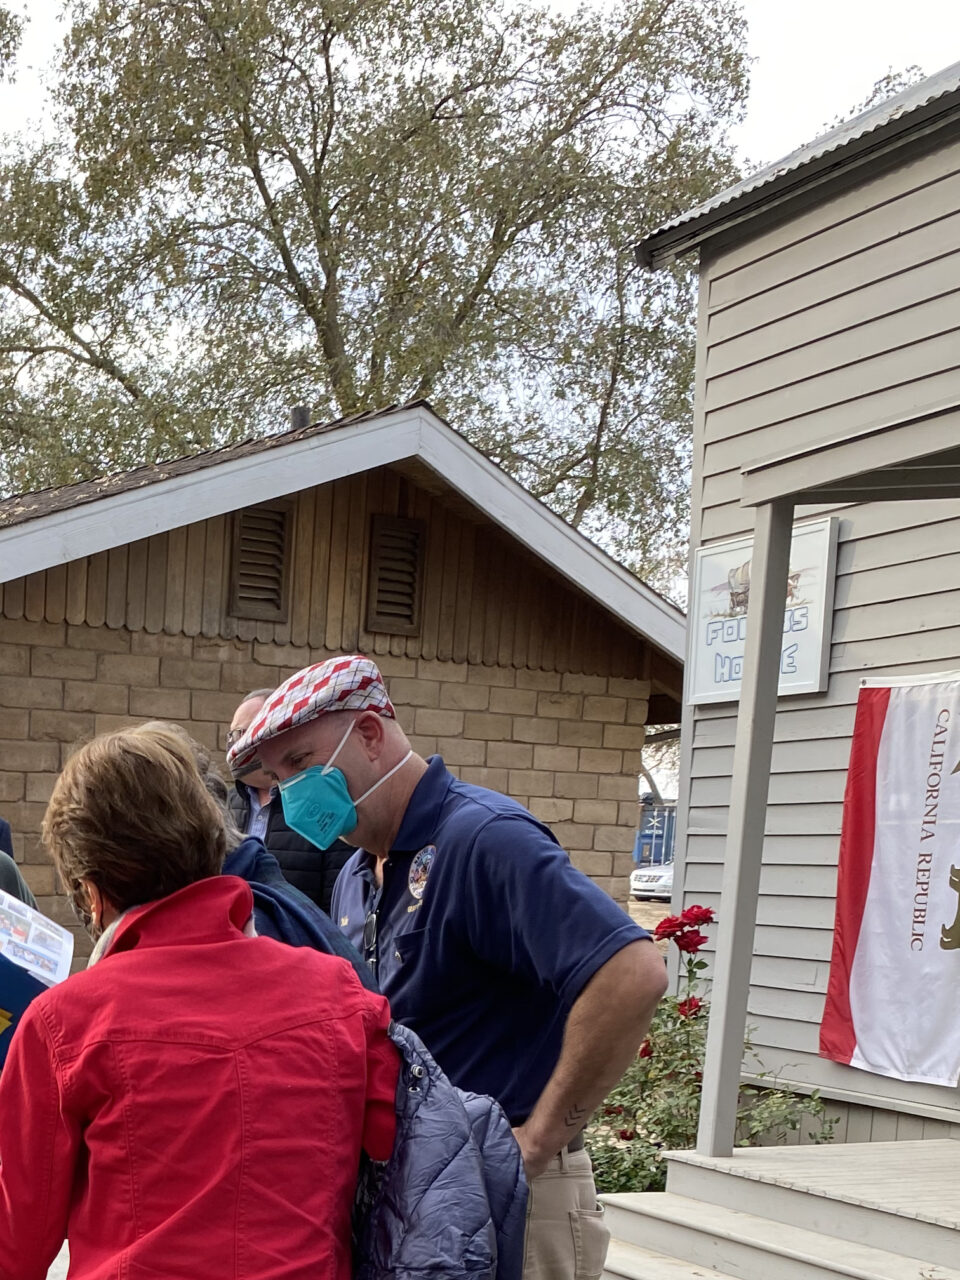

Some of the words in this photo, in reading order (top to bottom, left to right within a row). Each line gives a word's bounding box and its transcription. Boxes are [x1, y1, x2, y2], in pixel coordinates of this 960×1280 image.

[715, 644, 798, 682] HOE
[920, 708, 950, 841] CALIFORNIA
[910, 852, 932, 952] REPUBLIC
